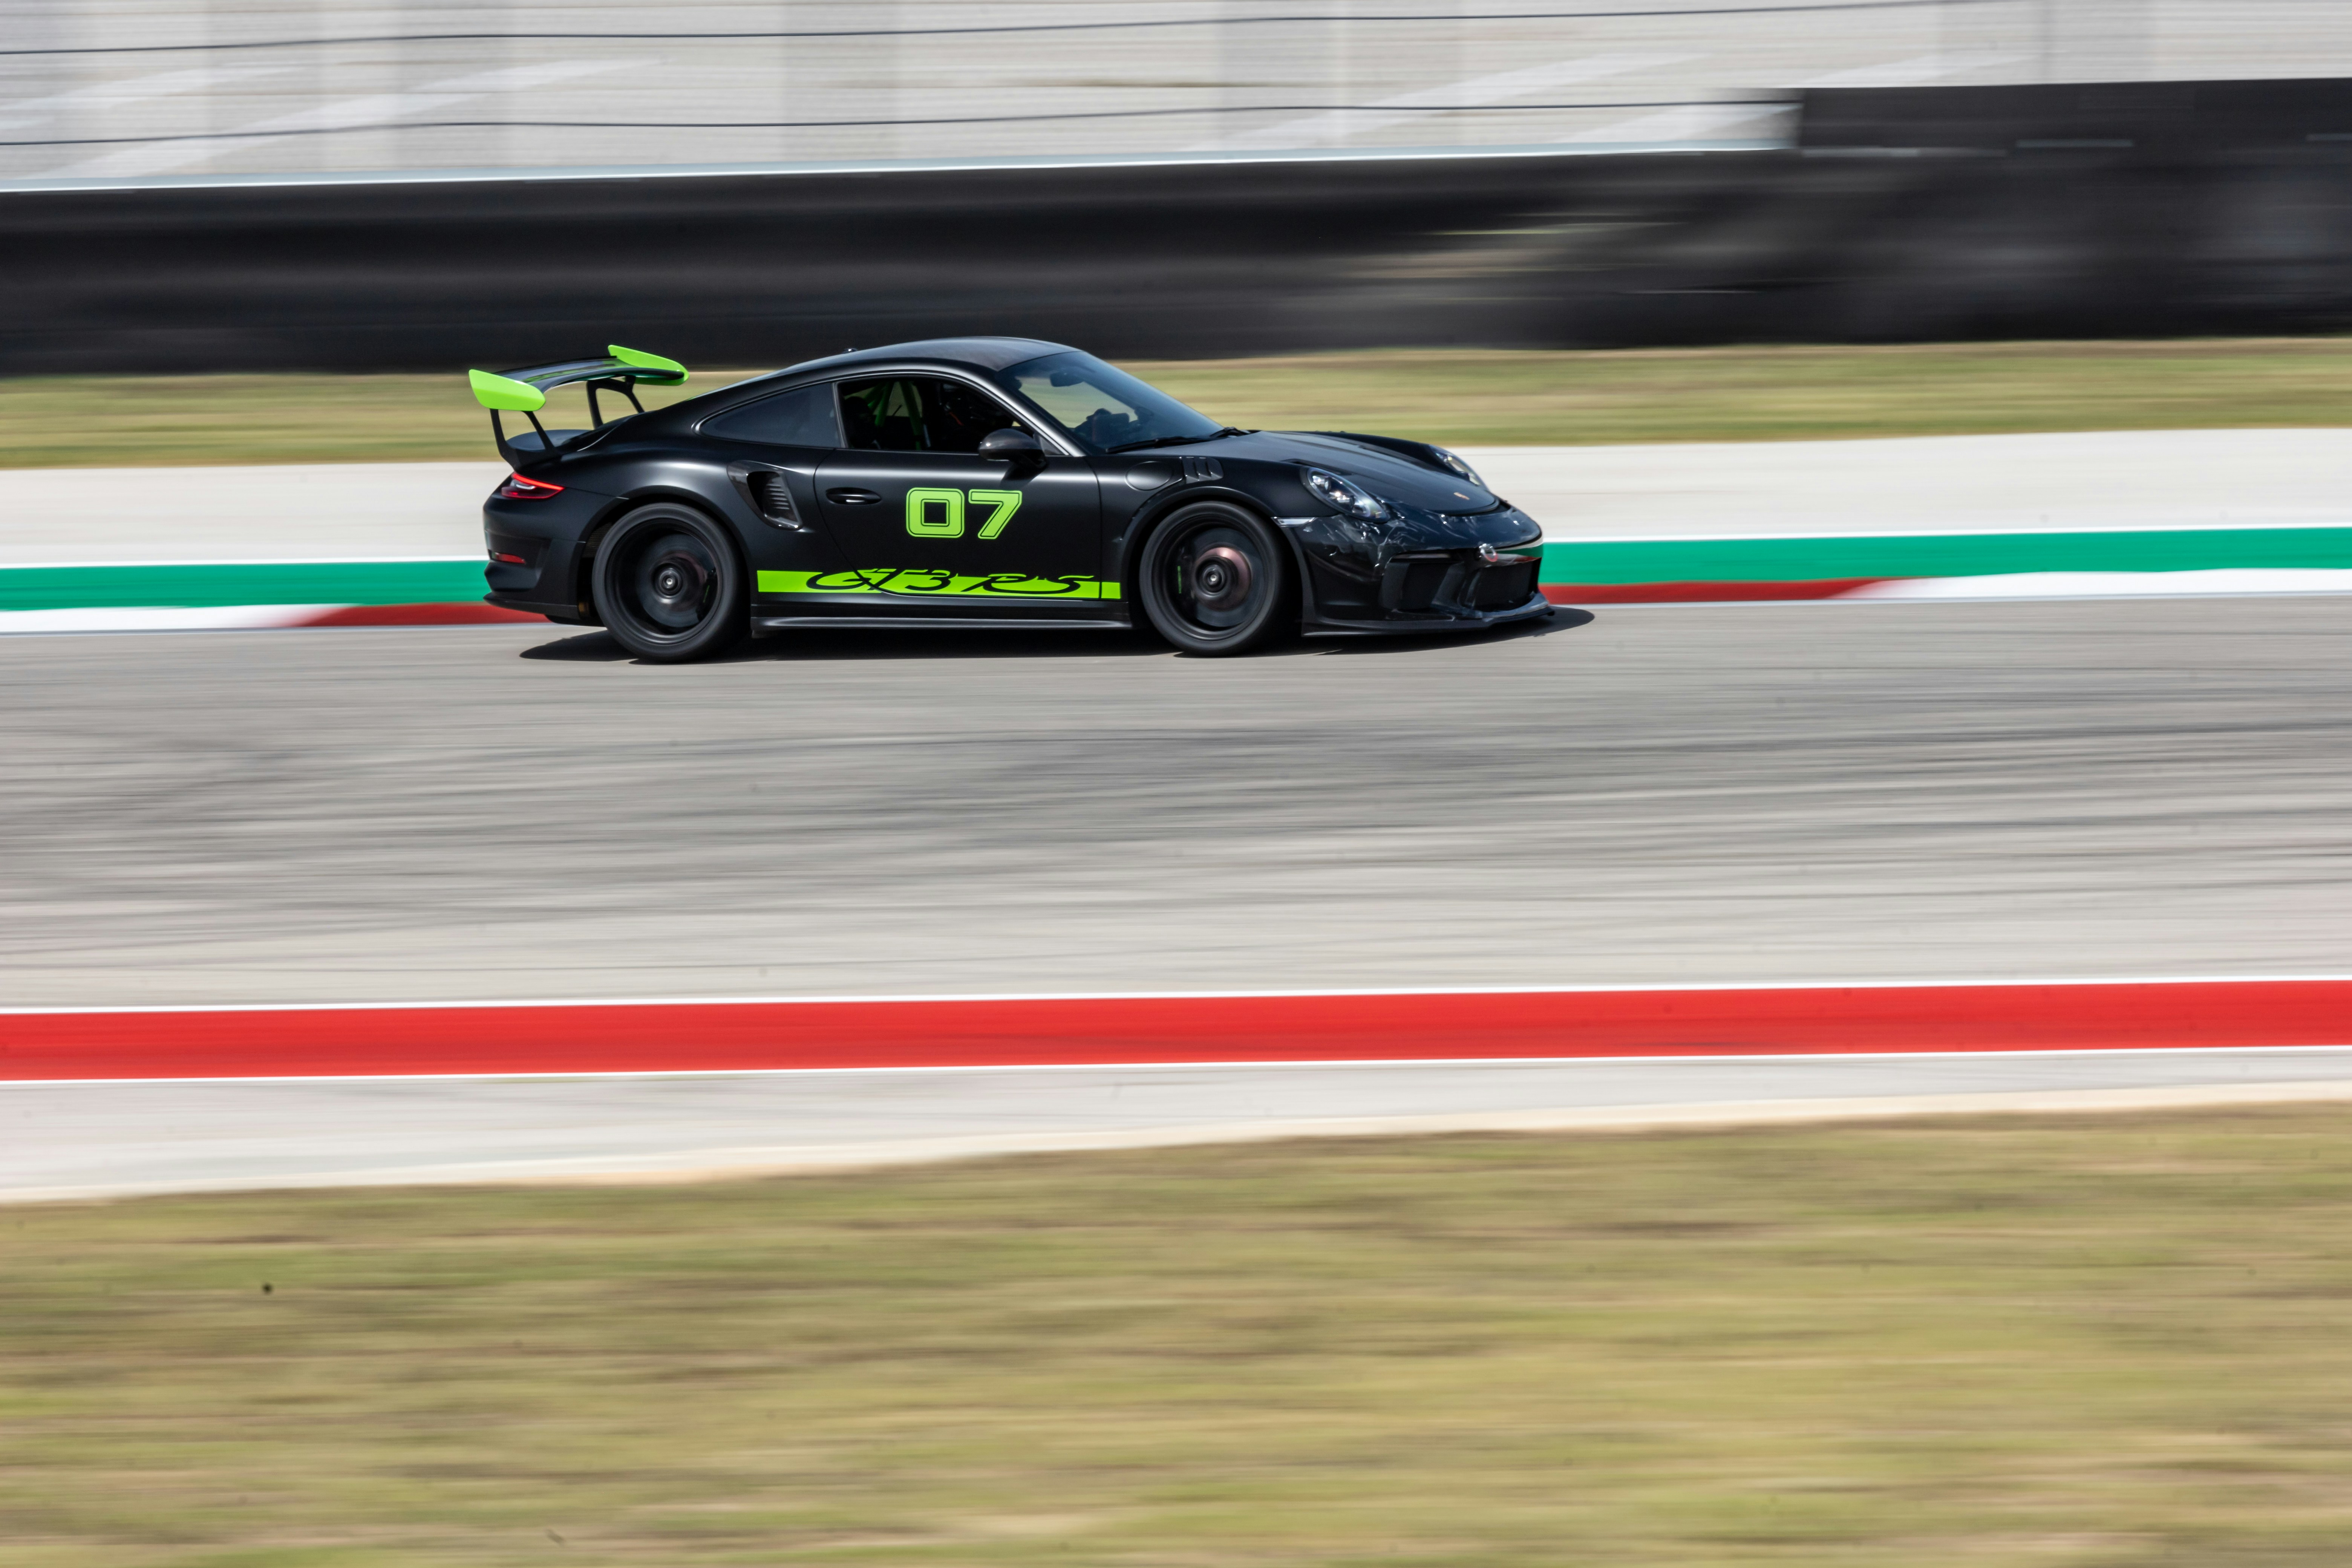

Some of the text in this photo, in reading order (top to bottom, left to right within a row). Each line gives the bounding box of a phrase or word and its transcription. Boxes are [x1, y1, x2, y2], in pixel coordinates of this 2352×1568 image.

[906, 487, 1022, 539] 07
[806, 568, 1095, 594] GT3 RS
